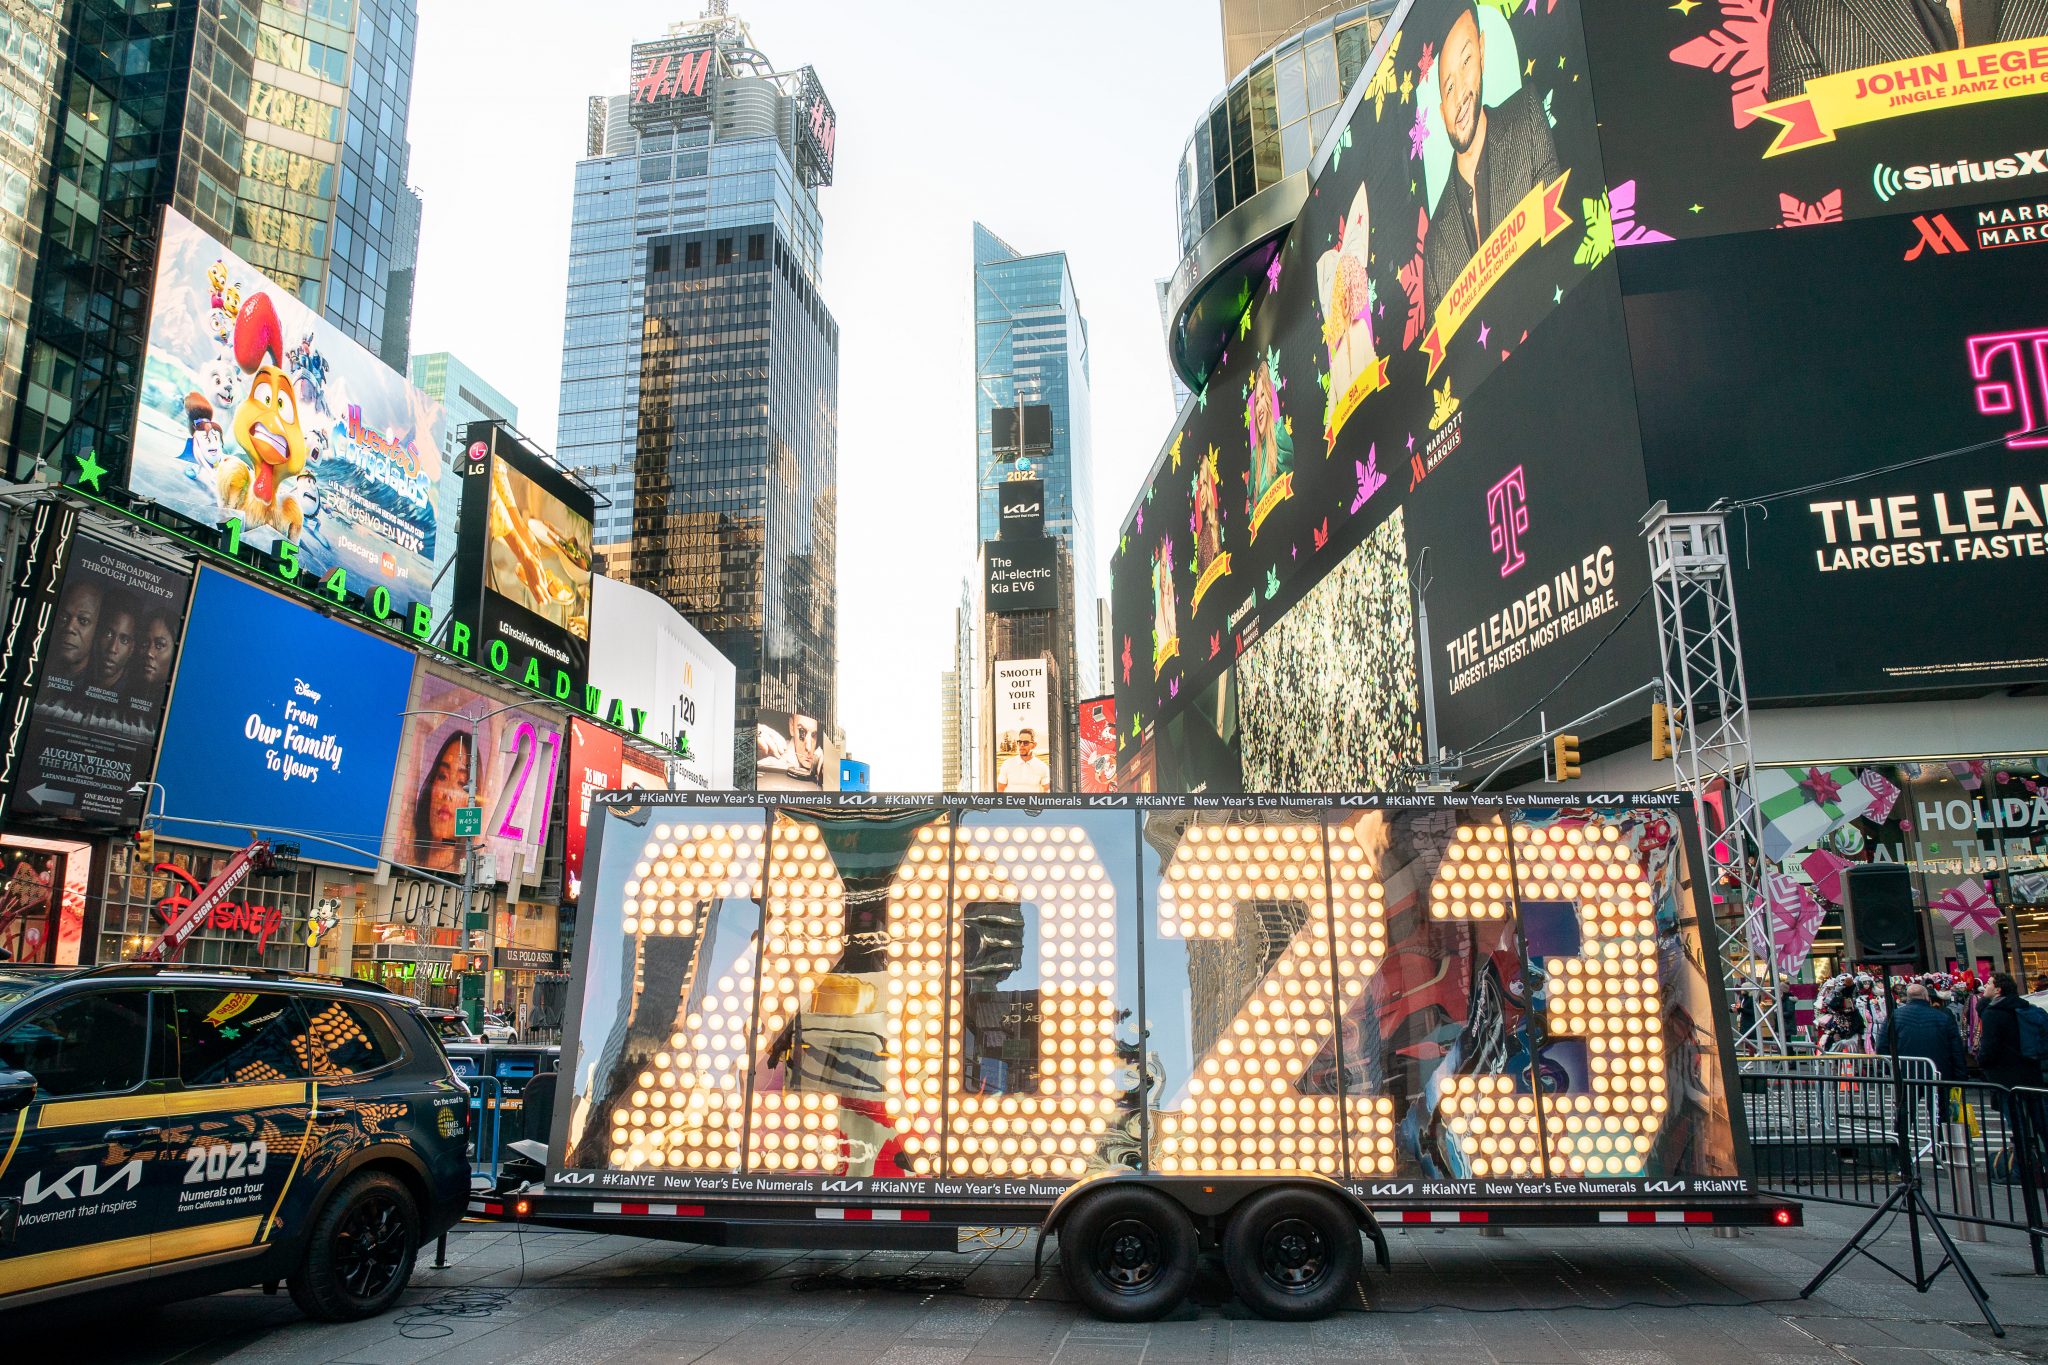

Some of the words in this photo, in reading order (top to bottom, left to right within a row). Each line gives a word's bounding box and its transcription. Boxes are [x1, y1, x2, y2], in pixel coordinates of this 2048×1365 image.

[634, 49, 712, 104] H&M
[1855, 61, 1948, 99] JOHN
[1888, 87, 1947, 107] JINGLE
[1951, 79, 1999, 96] JAMZ
[2002, 73, 2036, 89] (CH
[1903, 148, 2048, 191] SiriusX
[1448, 266, 1477, 317] JOHN
[1478, 210, 1527, 276] LEGEND
[1425, 410, 1464, 455] MARRIOTT
[1427, 431, 1461, 470] MARQUIS
[468, 463, 485, 475] LG
[1003, 502, 1040, 514] KIA
[1809, 494, 1922, 544] THE
[1933, 483, 2048, 535] LEA
[990, 558, 1012, 568] The
[1816, 540, 1951, 572] LARGEST.
[1955, 532, 2048, 562] FASTE
[82, 558, 127, 582] THROUGH
[127, 576, 166, 597] JANUARY
[165, 590, 174, 600] 29
[100, 555, 115, 568] ON
[115, 560, 162, 585] BROADWAY
[990, 568, 1051, 581] All-electric
[990, 583, 1009, 594] Kia
[1012, 581, 1035, 593] EV6
[1446, 626, 1479, 675] THE
[1481, 584, 1553, 654] LEADER
[1554, 564, 1580, 615] IN
[1582, 545, 1615, 596] 5G
[1448, 662, 1488, 696] LARGEST.
[1487, 637, 1531, 678] FASTEST.
[1530, 623, 1561, 653] MOST
[1561, 591, 1619, 640] RELIABLE.
[412, 602, 648, 735] BROADWAY
[1000, 668, 1042, 678] SMOOTH
[1011, 679, 1032, 688] OUT
[294, 677, 322, 705] Disney
[1008, 690, 1036, 699] YOUR
[1012, 701, 1032, 710] LIFE
[284, 700, 319, 730] From
[679, 693, 695, 727] 120
[244, 713, 282, 745] Our
[283, 723, 343, 771] Family
[38, 755, 61, 768] THE
[61, 758, 95, 775] PIANO
[95, 765, 132, 782] LESSON
[41, 747, 85, 763] AUGUST
[87, 754, 132, 772] WILSON'S
[265, 749, 281, 771] To
[282, 753, 319, 783] Yours
[497, 721, 561, 846] 21
[595, 791, 633, 803] KIA
[639, 791, 688, 804] #KiaNYE
[695, 793, 721, 804] New
[722, 792, 755, 805] Year's
[757, 793, 777, 805] Eve
[779, 793, 832, 806] Numerals
[1089, 795, 1128, 806] KIA
[1135, 795, 1186, 806] #KiaNYE
[1193, 795, 1219, 806] New
[1221, 795, 1255, 806] Year's
[1257, 796, 1278, 806] Eve
[1280, 795, 1333, 806] Numerals
[175, 919, 195, 945] AMA
[193, 896, 213, 924] SIGN
[217, 860, 251, 899] ELECTRIC
[507, 950, 519, 961] U.S.
[519, 950, 537, 962] POLO
[608, 822, 1669, 1177] 2023
[448, 1097, 458, 1105] road
[444, 1120, 459, 1129] TIMES
[183, 1141, 268, 1185] 2023
[22, 1159, 143, 1206] KIA
[179, 1187, 228, 1203] Numerals
[229, 1186, 242, 1196] on
[243, 1181, 265, 1194] tour
[553, 1171, 595, 1184] KIA
[602, 1173, 656, 1187] #KiaNYE
[664, 1175, 692, 1188] New
[694, 1176, 729, 1190] Year's
[731, 1178, 753, 1191] Eve
[756, 1178, 814, 1192] Numerals
[1371, 1183, 1414, 1195] KIA
[1422, 1183, 1477, 1195] #KiaNYE
[1485, 1183, 1513, 1195] New
[1515, 1182, 1552, 1195] Year's
[1554, 1182, 1576, 1194] Eve
[1579, 1180, 1637, 1194] Numerals
[17, 1208, 75, 1227] Movement
[77, 1204, 99, 1217] that
[100, 1199, 138, 1215] inspires
[178, 1203, 195, 1212] from
[194, 1199, 226, 1211] California
[234, 1196, 248, 1205] New
[248, 1194, 262, 1203] York
